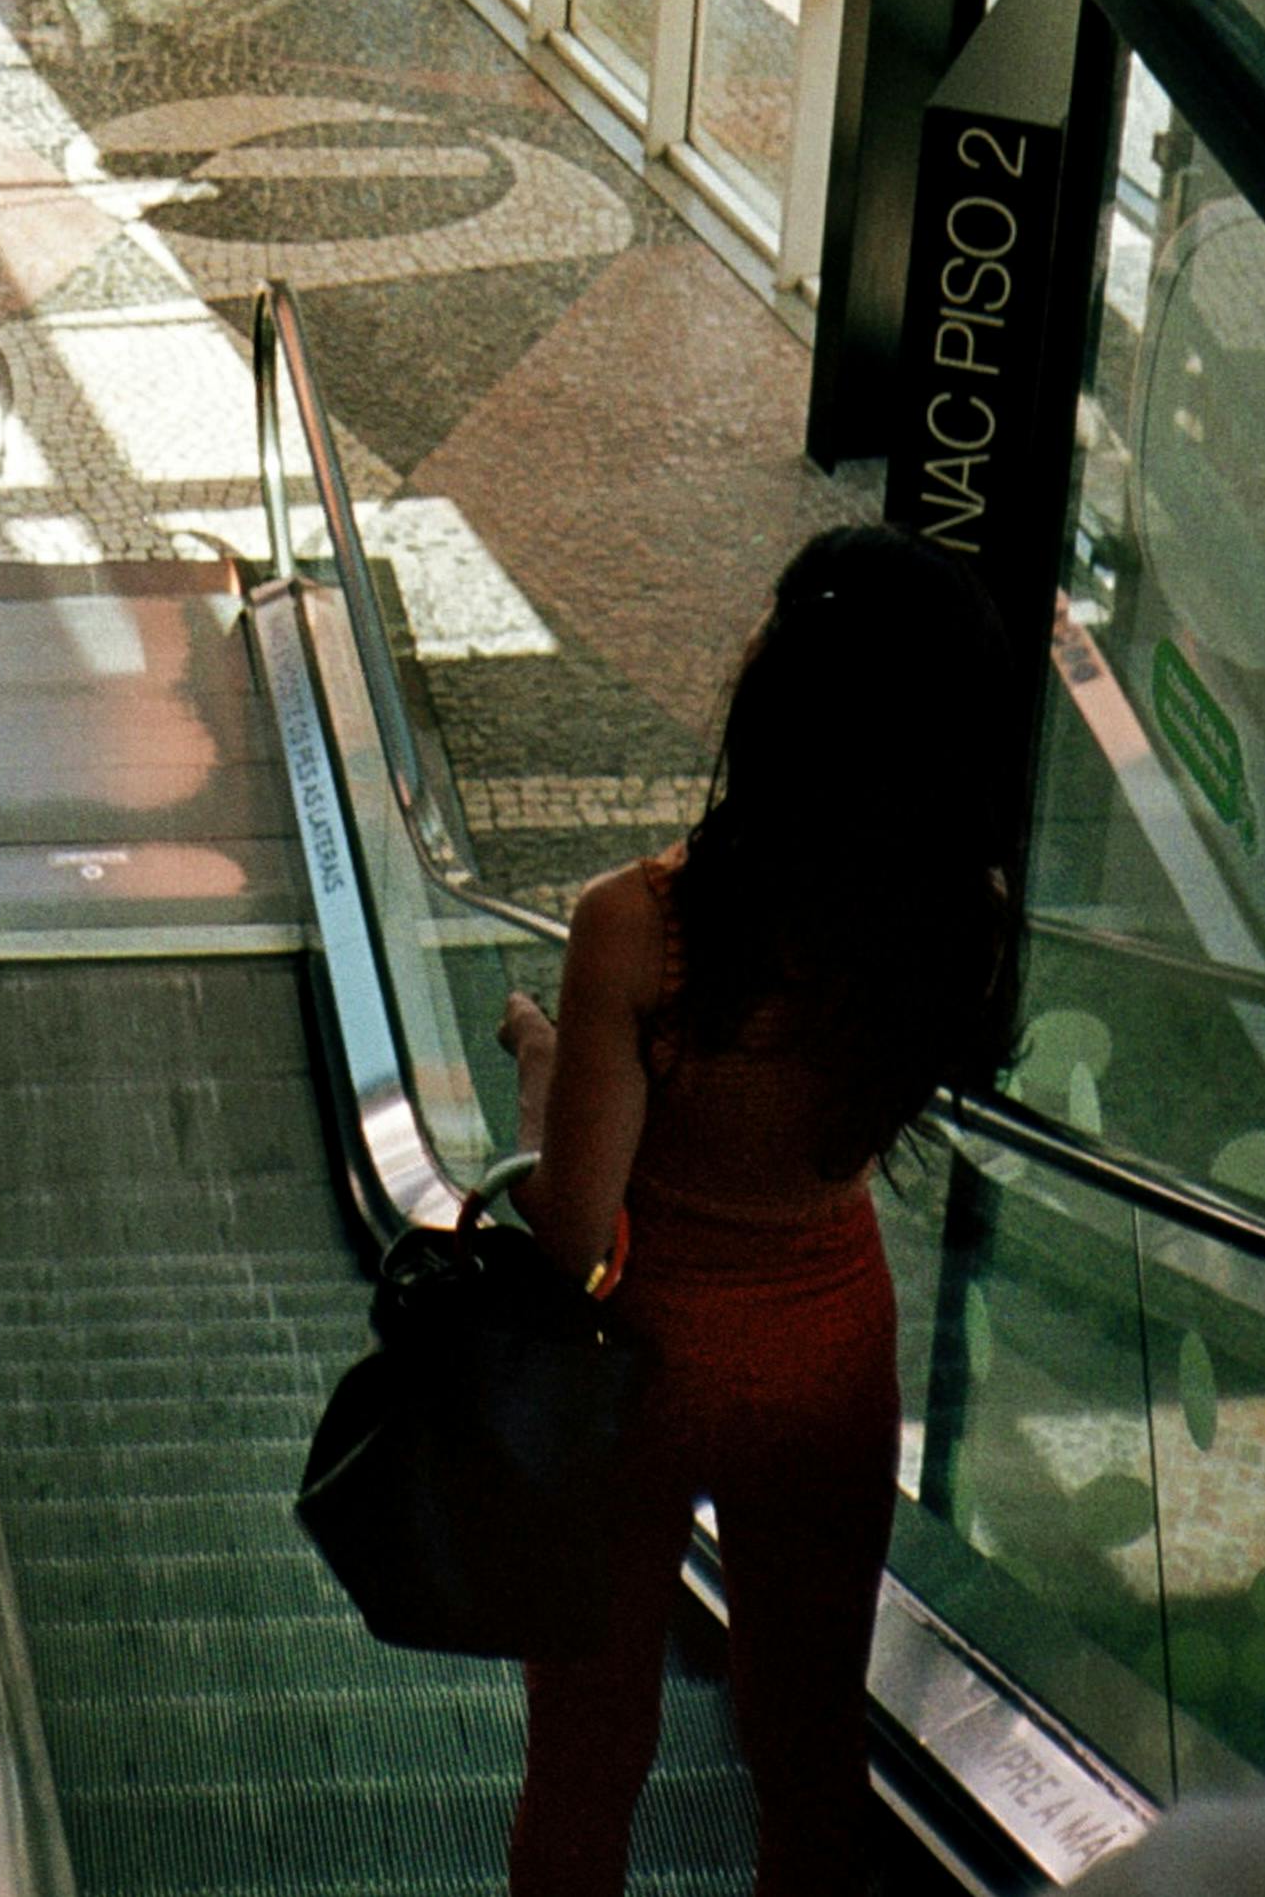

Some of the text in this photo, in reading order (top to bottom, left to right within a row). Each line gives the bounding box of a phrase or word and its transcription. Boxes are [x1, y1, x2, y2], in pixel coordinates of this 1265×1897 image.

[956, 126, 1027, 179] 2
[933, 195, 1018, 376] PISO
[307, 806, 345, 895] LATERAIS
